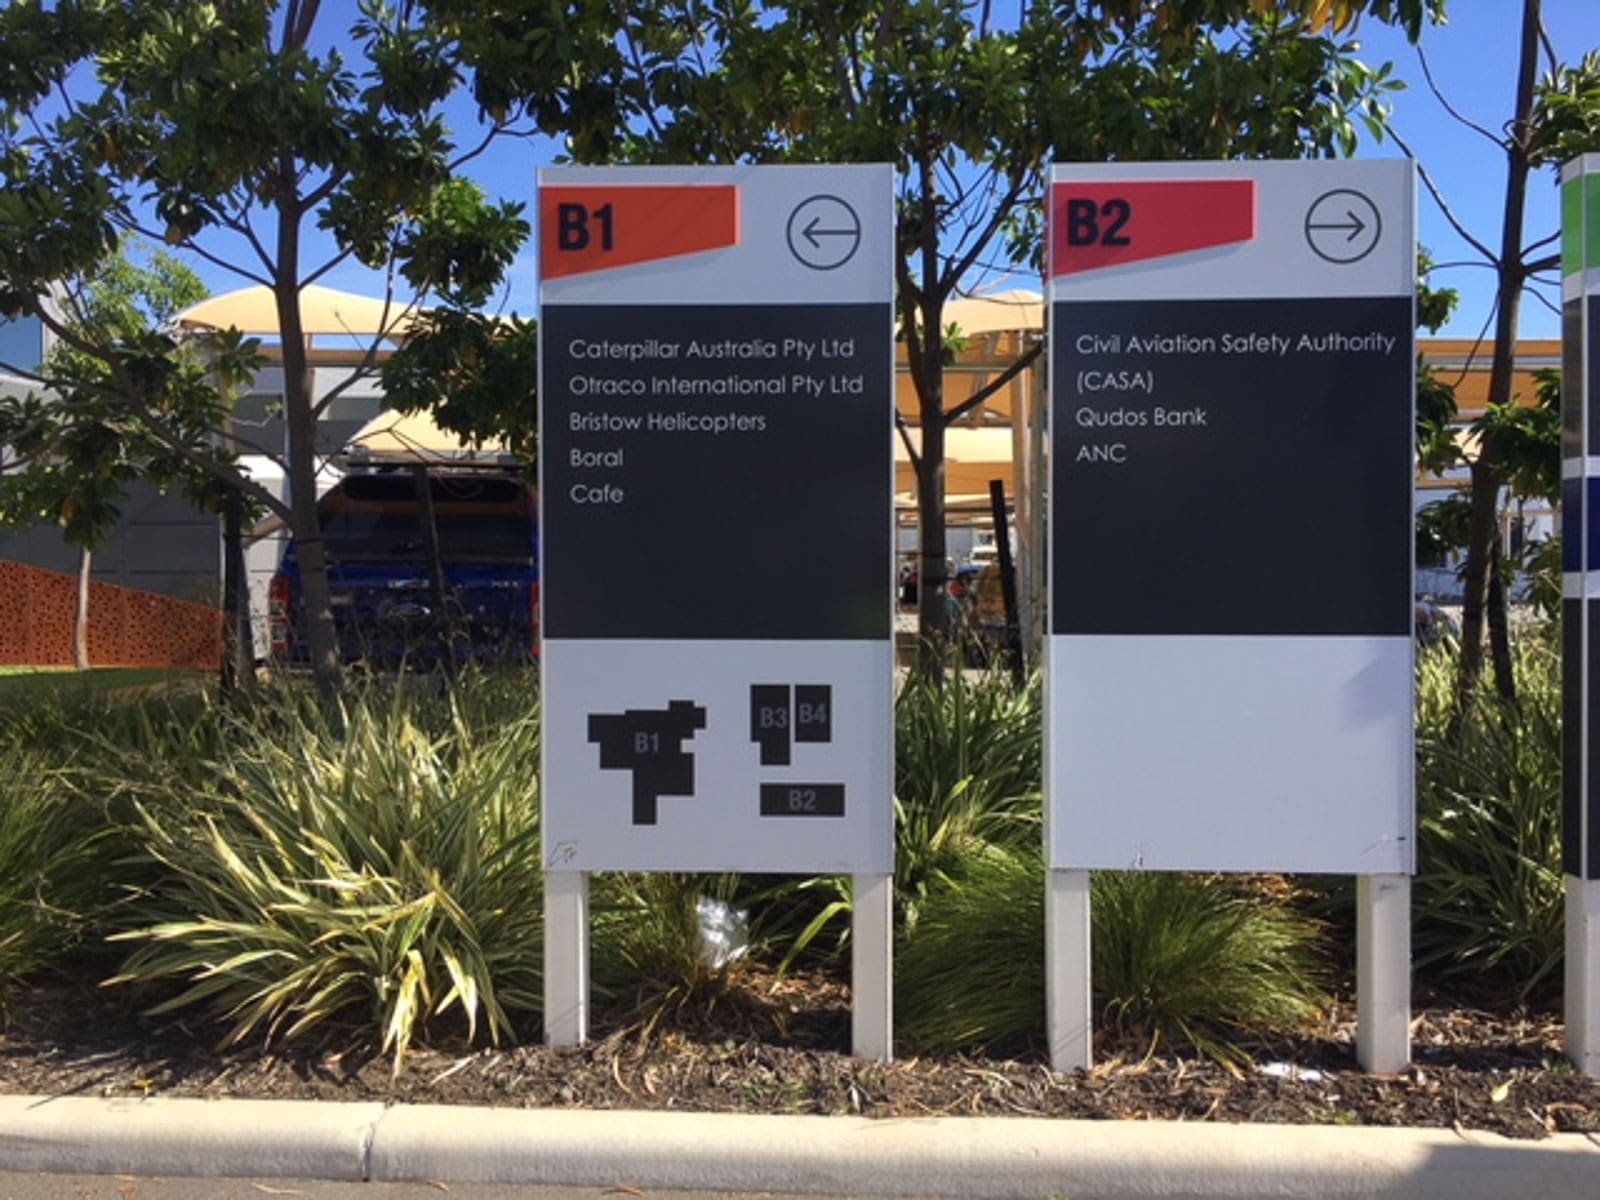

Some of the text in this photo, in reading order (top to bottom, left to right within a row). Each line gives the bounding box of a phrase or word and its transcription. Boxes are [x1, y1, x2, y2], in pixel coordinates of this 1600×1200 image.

[558, 203, 614, 251] B1
[1067, 198, 1131, 247] B2
[569, 338, 854, 361] Caterpillar Australia Pty Ltd
[1076, 332, 1396, 356] Civil Aviation Safety Authority
[569, 374, 864, 398] Otraco International Pty Ltd
[1076, 371, 1153, 394] (CASA)
[569, 411, 766, 434] Bristow Helicopters
[1075, 406, 1206, 427] Qudos Bank
[570, 448, 623, 467] Boral
[1076, 443, 1126, 463] ANC
[569, 484, 624, 504] Cafe
[760, 706, 788, 729] B3
[799, 703, 827, 724] B4
[634, 731, 660, 753] B1
[788, 789, 816, 811] B2
